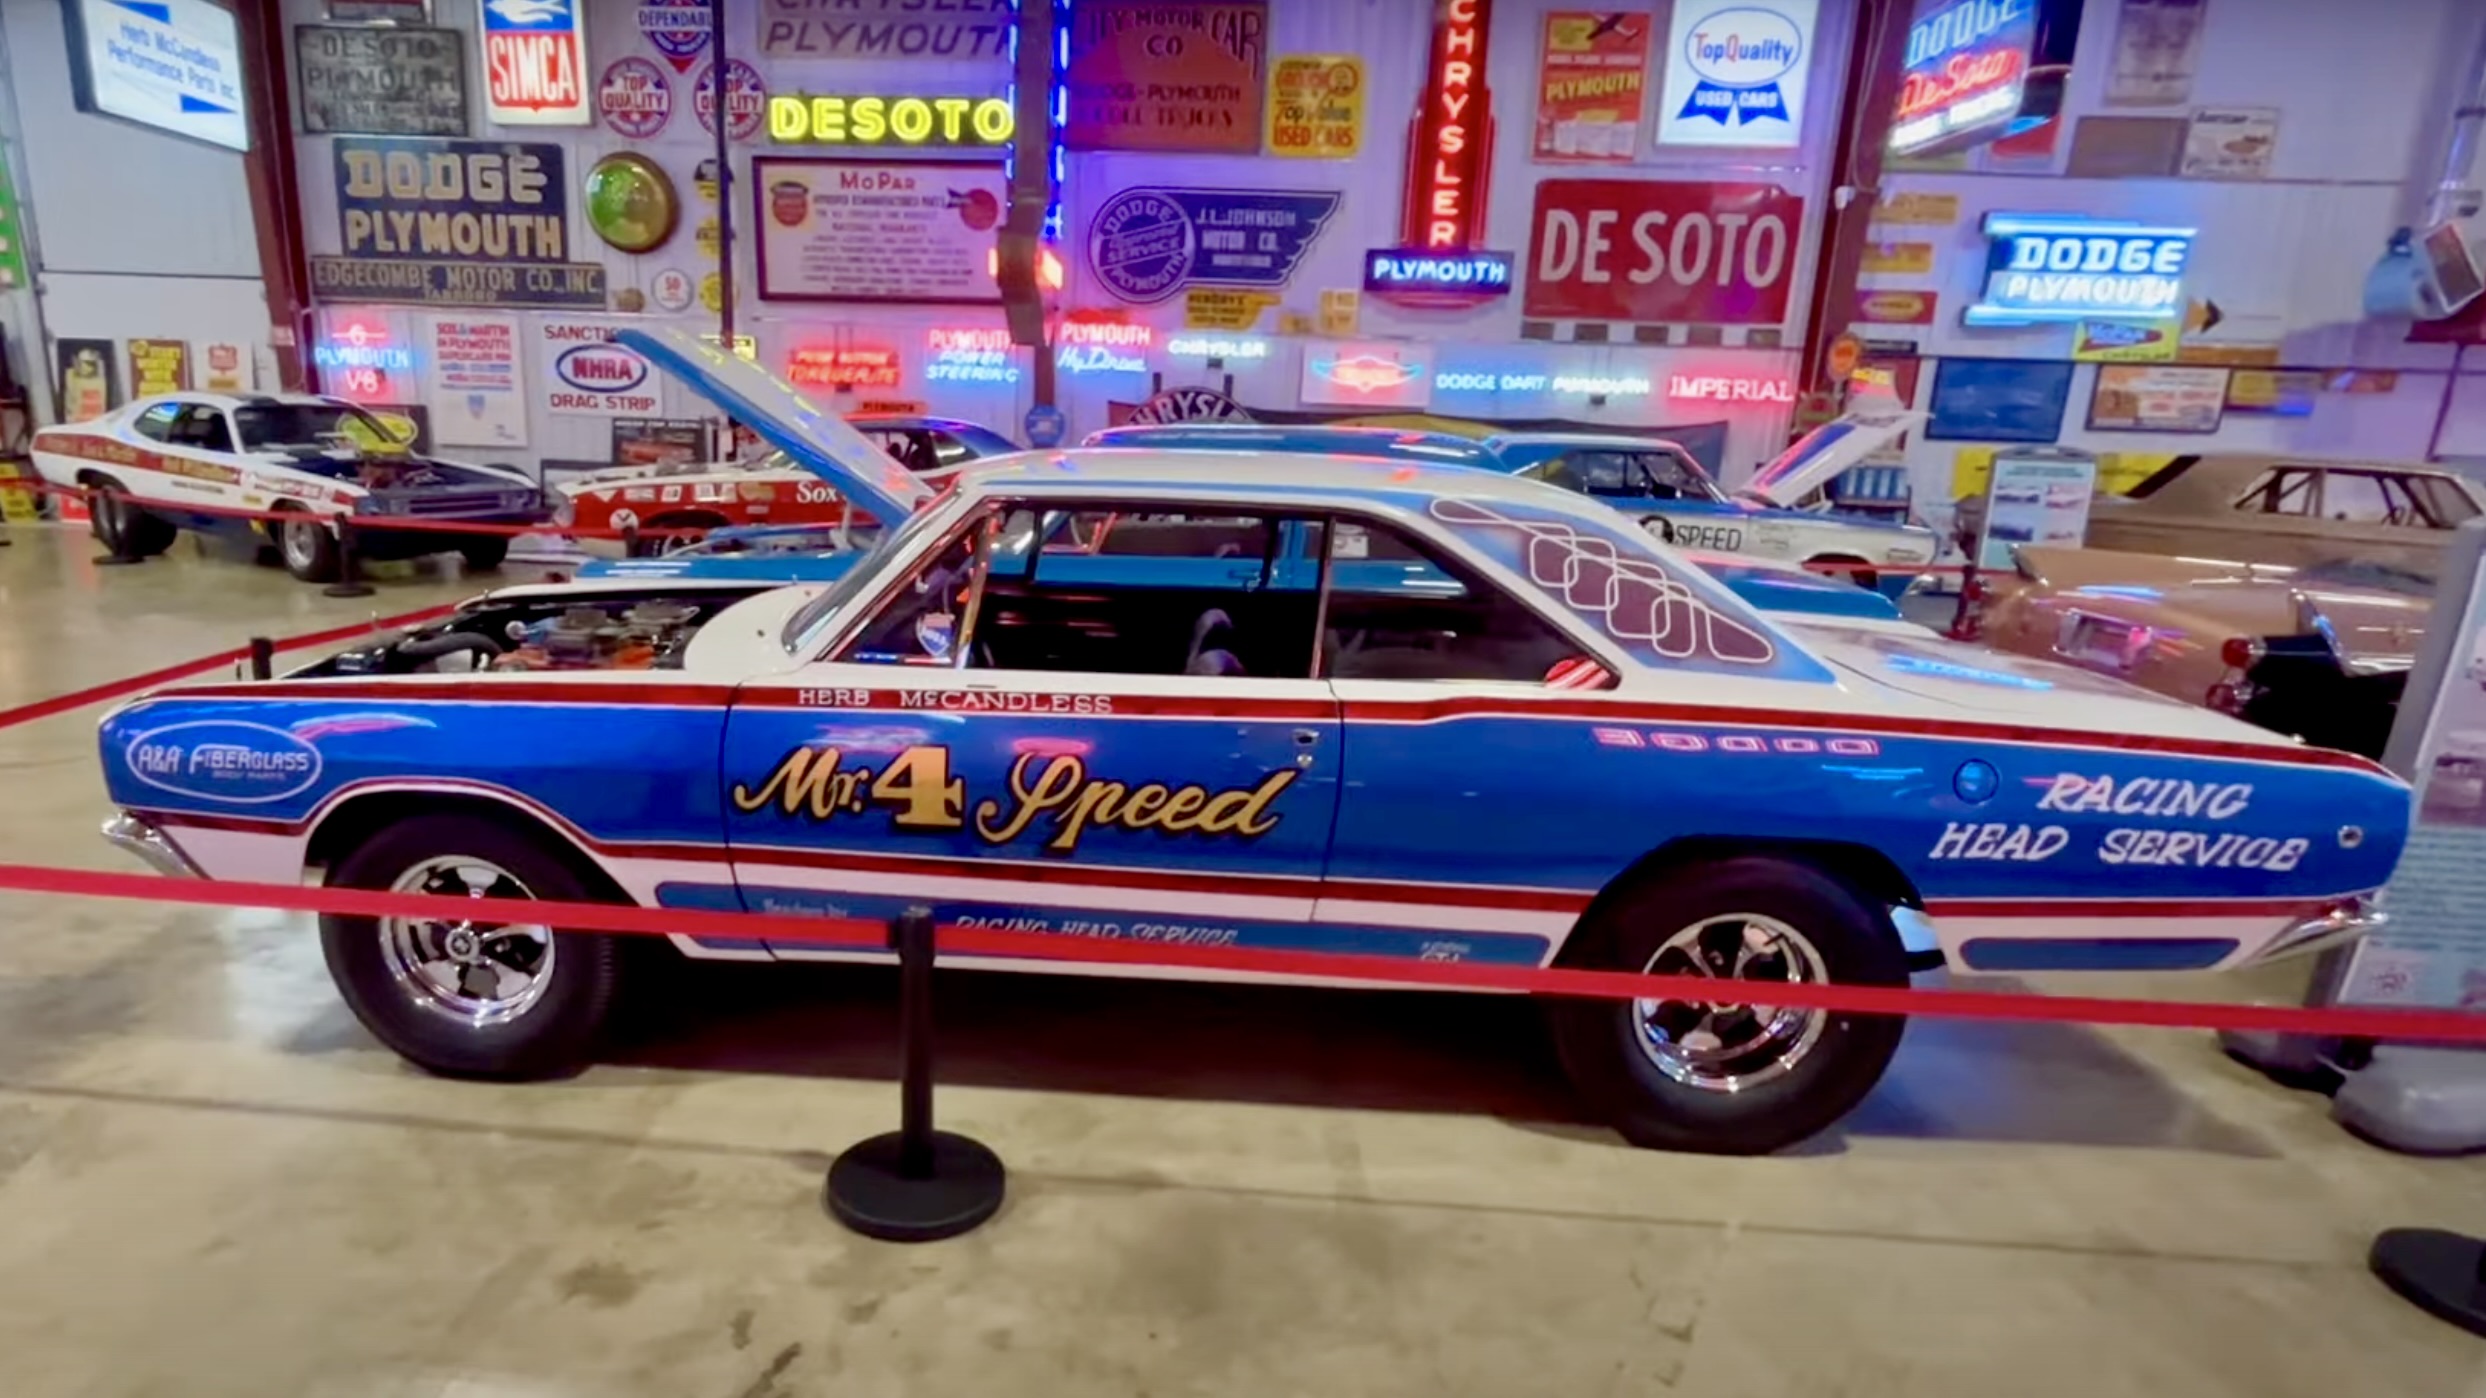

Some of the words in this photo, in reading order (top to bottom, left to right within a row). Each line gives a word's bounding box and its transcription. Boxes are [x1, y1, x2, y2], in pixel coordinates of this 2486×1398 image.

[638, 10, 713, 27] DEPENDABL
[490, 35, 577, 102] SIMCA
[622, 74, 648, 92] TOP
[1546, 70, 1641, 102] PLYMOUTH
[605, 93, 664, 112] QUALITY
[1694, 90, 1734, 108] USED
[1738, 91, 1778, 108] CARS
[769, 96, 1015, 142] DESOTO
[1429, 0, 1476, 248] CHRYSLER
[342, 149, 548, 203] DODGE
[1103, 199, 1175, 233] DODGE
[345, 208, 563, 258] PLYMOUTH
[1539, 209, 1619, 283] DE
[1628, 210, 1787, 288] SOTO
[2009, 236, 2188, 274] DODGE
[314, 262, 433, 289] EDGECOMBE
[447, 266, 517, 291] MOTOR
[1373, 256, 1507, 284] PLYMOUTH
[2005, 273, 2180, 307] PLYMOUTH
[1061, 322, 1150, 346] PLYMOUTH
[314, 346, 411, 369] PLYMOUTH
[1168, 338, 1267, 358] CHRYSLER
[346, 369, 379, 393] V8
[571, 356, 633, 381] NHRA
[925, 365, 1021, 384] STEERING
[1435, 373, 1497, 391] DODGE
[550, 393, 598, 409] DRAG
[604, 395, 656, 411] STRIP
[1668, 375, 1795, 402] IMPERIAL
[796, 481, 838, 503] Sox
[1675, 525, 1742, 552] SPEED
[799, 688, 870, 707] HERB
[870, 744, 964, 827] 4
[975, 748, 1297, 850] Speed
[2035, 772, 2254, 820] RACING
[1928, 821, 2070, 861] HEAD
[2098, 827, 2311, 872] SERVICE
